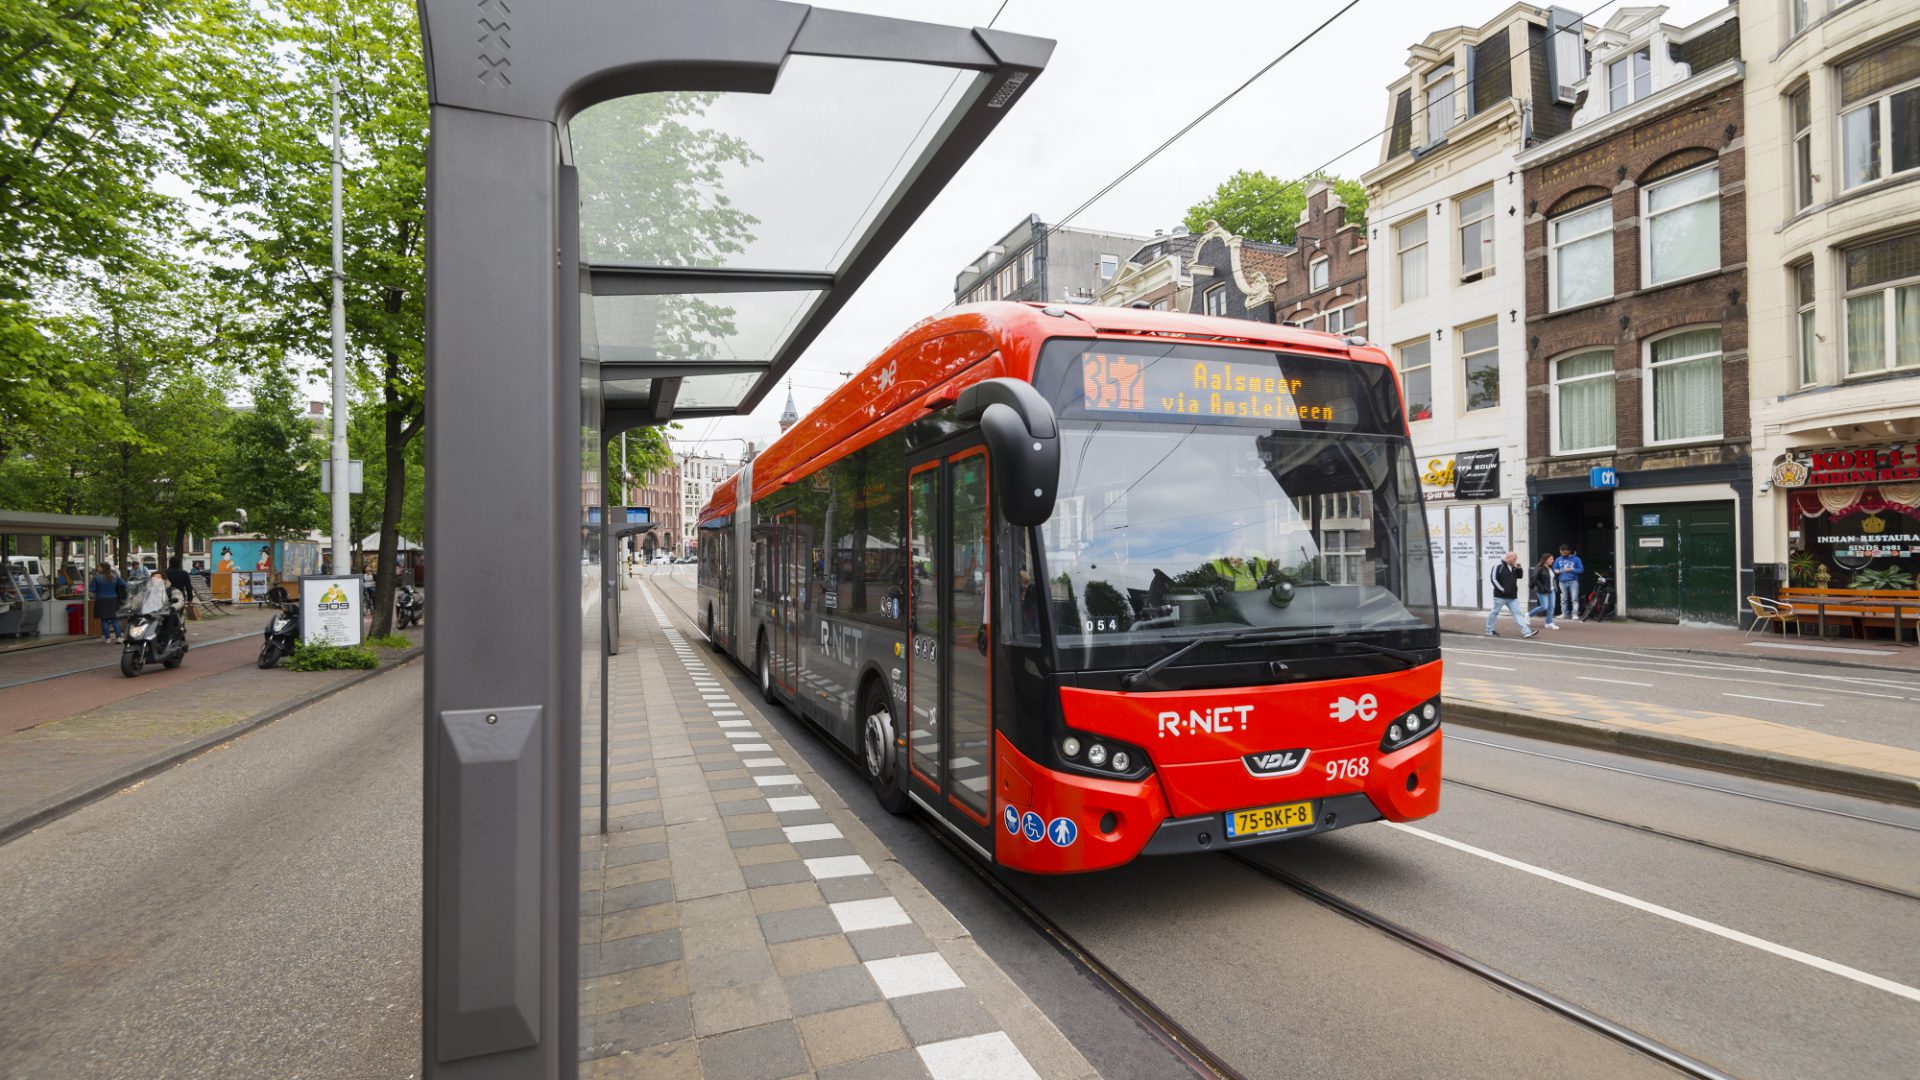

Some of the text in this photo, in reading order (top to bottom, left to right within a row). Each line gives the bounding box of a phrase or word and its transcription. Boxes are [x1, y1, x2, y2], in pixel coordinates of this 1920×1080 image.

[1193, 362, 1302, 395] Aalsmeer
[1162, 392, 1334, 421] via Amstelveen
[1810, 470, 1877, 485] INDIAN
[1817, 535, 1856, 543] INDIAN
[1252, 752, 1297, 769] VDL
[1325, 757, 1370, 781] 9768
[1239, 806, 1307, 832] 75-BKF-8
